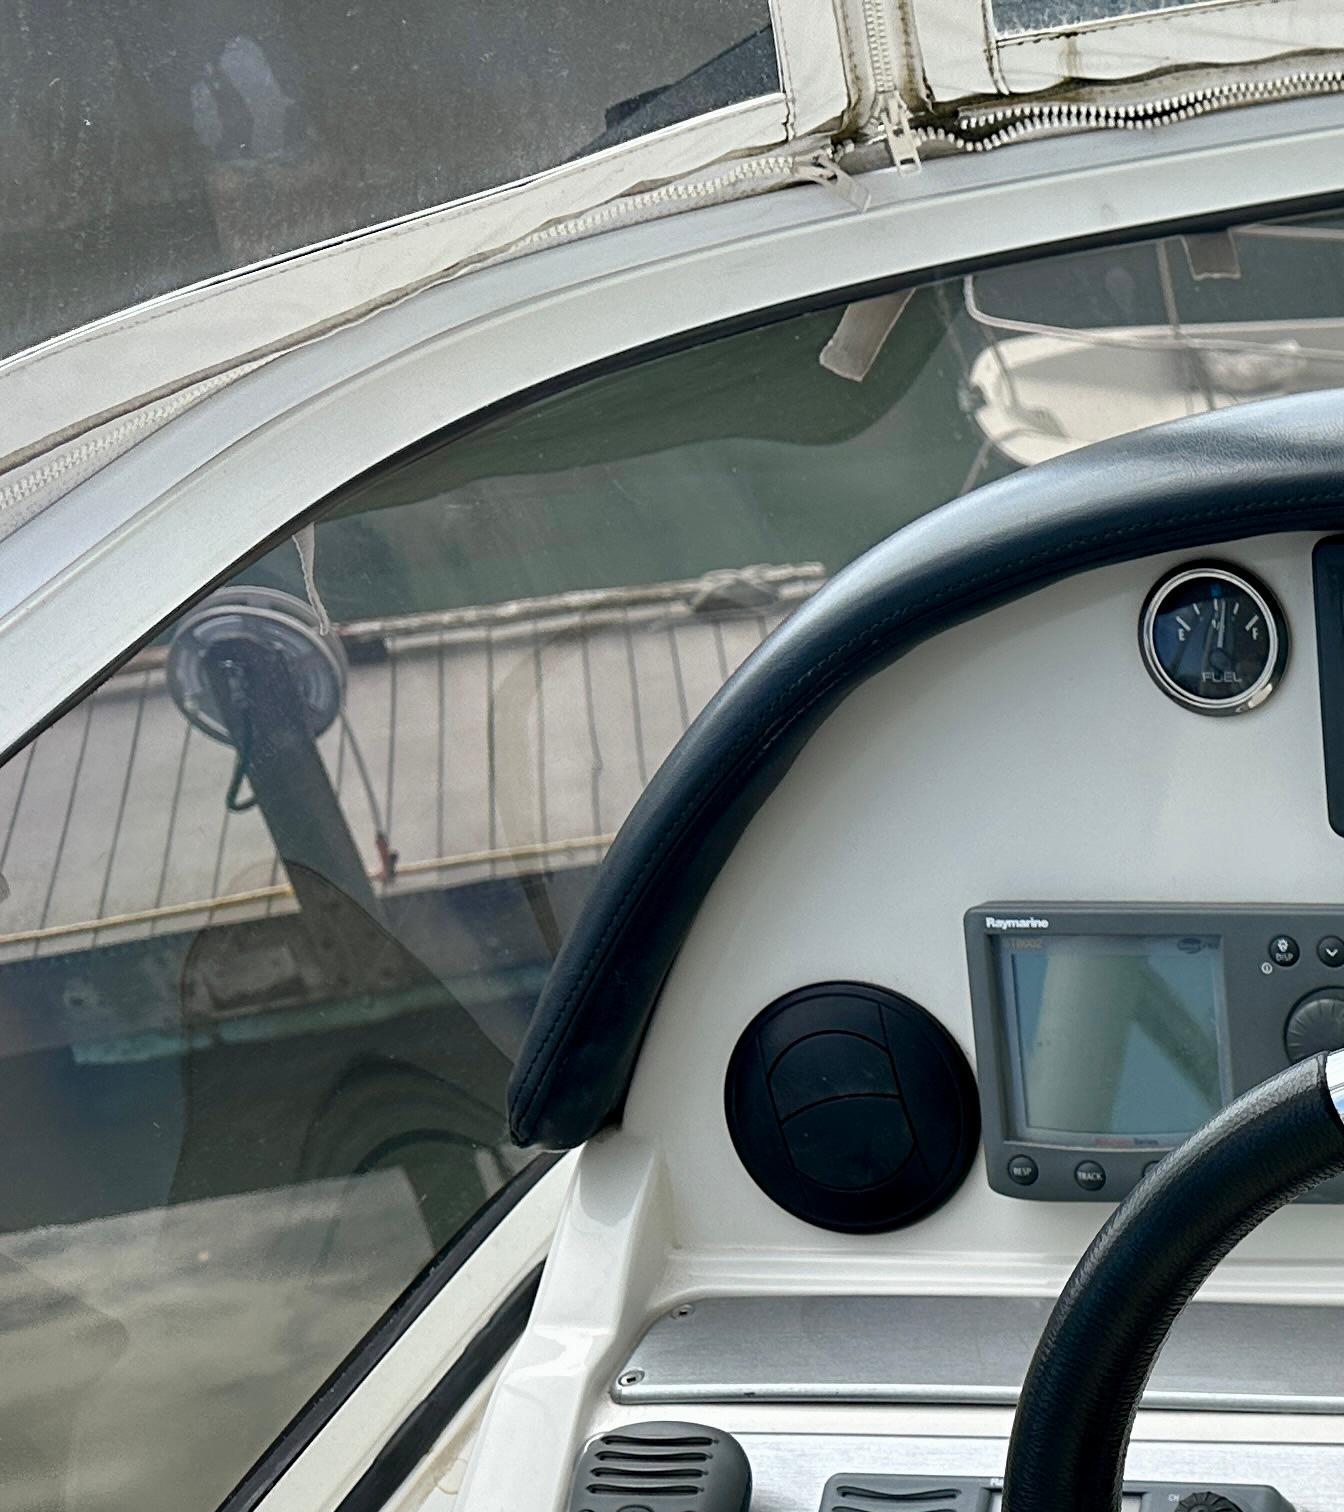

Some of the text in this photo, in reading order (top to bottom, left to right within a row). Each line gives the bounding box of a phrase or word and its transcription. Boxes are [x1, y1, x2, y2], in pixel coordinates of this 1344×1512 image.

[1200, 671, 1241, 683] FUEL
[985, 916, 1049, 930] Raymarine
[1076, 1171, 1104, 1182] TRACK
